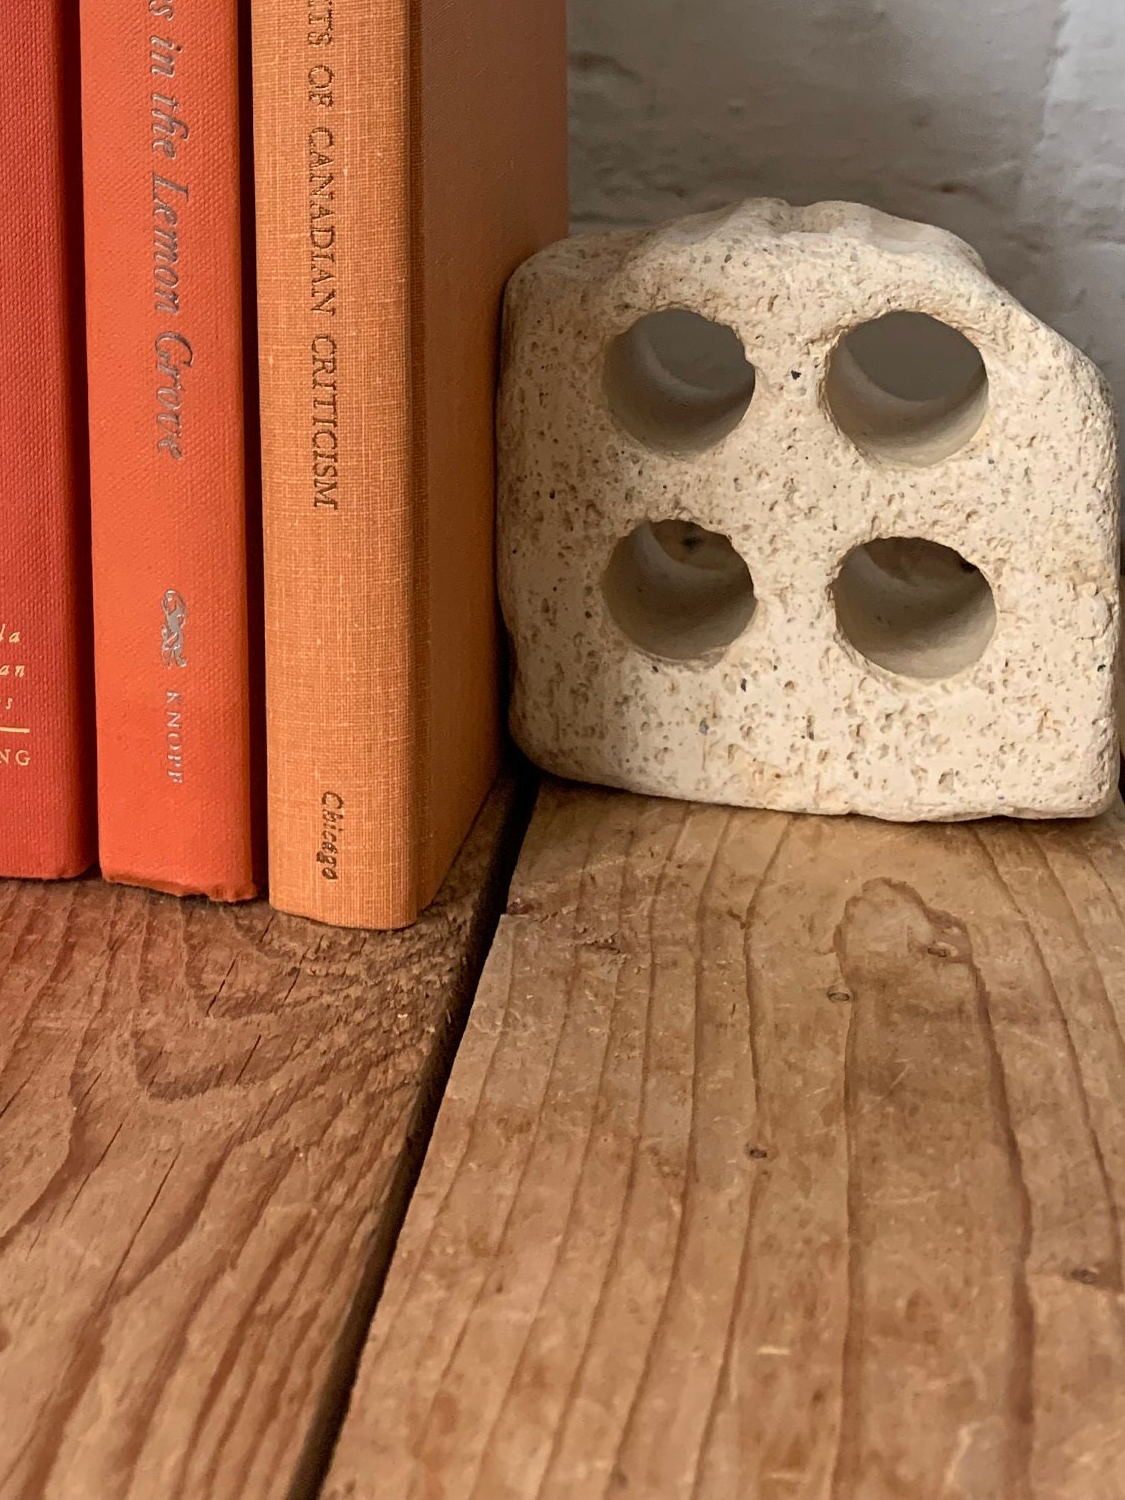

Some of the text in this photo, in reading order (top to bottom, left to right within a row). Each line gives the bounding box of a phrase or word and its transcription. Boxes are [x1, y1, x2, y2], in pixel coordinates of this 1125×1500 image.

[150, 32, 183, 78] in
[308, 65, 334, 108] OF
[152, 91, 188, 162] the
[149, 171, 190, 315] Lemon
[308, 127, 337, 316] CANADIAN
[154, 330, 193, 461] Grove
[312, 335, 338, 509] CRITICISM
[165, 690, 183, 783] KNOPF
[317, 791, 345, 882] Chicago
